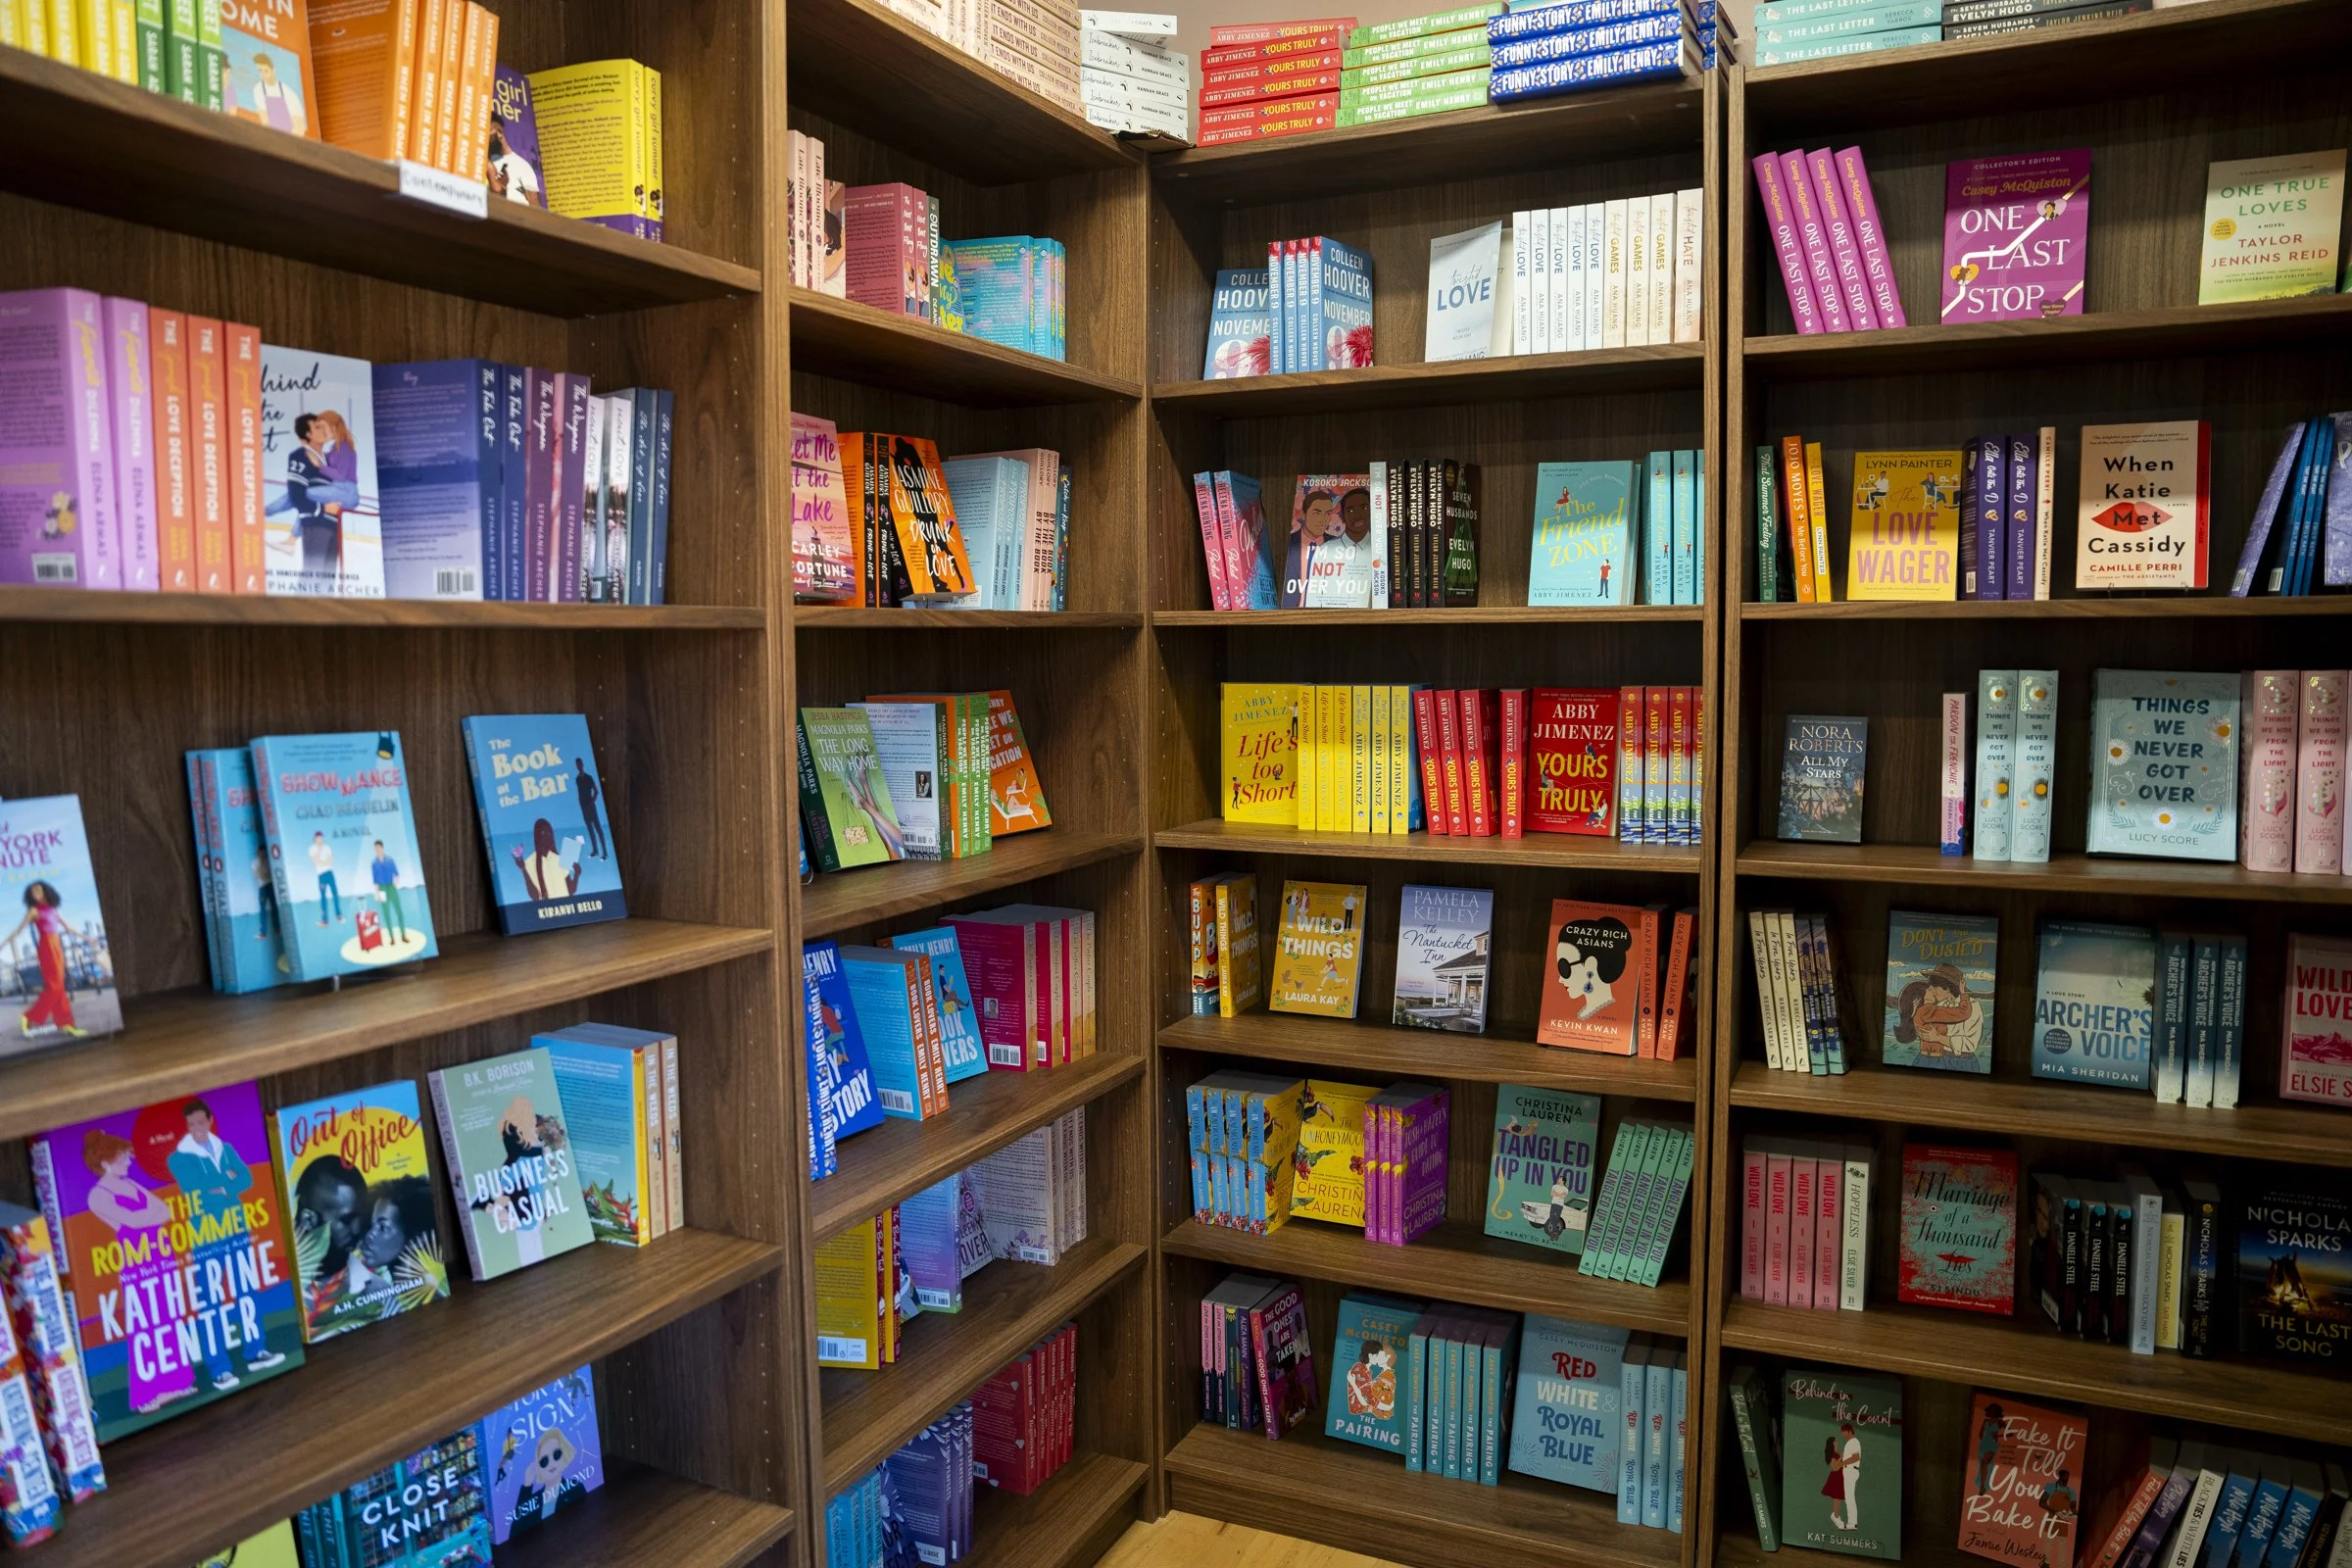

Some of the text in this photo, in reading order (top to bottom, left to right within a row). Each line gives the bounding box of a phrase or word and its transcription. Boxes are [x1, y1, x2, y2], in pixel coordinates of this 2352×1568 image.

[1953, 4, 2033, 22] EVELYN HUGO
[1788, 18, 1875, 38] THE LAST LETTER
[1206, 49, 1256, 64] ABBY JIMENEZ
[1266, 38, 1317, 55] YOURS TRULY
[1588, 49, 1657, 75] EMILY HENRY
[1083, 70, 1115, 87] Icebreaker
[1502, 62, 1574, 90] FUNNY STORY
[497, 78, 527, 106] girl
[2221, 177, 2329, 198] ONE TRUE
[2239, 199, 2307, 216] LOVES
[1961, 205, 2026, 233] ONE
[930, 213, 939, 288] OUTDRAWN
[1684, 236, 1693, 265] HATE
[2238, 234, 2302, 248] TAYLOR
[1331, 247, 1362, 270] COLLEEN
[1987, 239, 2070, 270] LAST
[2211, 249, 2328, 268] JENKINS REID
[1324, 264, 1370, 298] HOOVER
[1438, 277, 1490, 311] LOVE
[1968, 284, 2045, 314] STOP
[1324, 299, 1371, 325] NOVEMBER
[814, 433, 836, 462] Me
[1867, 459, 1952, 469] LYNN PAINTER
[2104, 456, 2174, 471] When
[808, 466, 829, 487] the
[893, 465, 941, 490] JASMINE
[2105, 483, 2171, 499] Katie
[895, 490, 950, 514] GUILLORY
[1446, 507, 1478, 519] HUSBANDS
[1539, 497, 1625, 546] Friend
[2113, 511, 2161, 525] Met
[909, 519, 956, 543] DRUNK
[1873, 513, 1938, 546] LOVE
[1305, 546, 1355, 560] I'M SO
[1449, 539, 1474, 551] EVELYN
[1549, 532, 1618, 567] ZONE
[2087, 536, 2185, 556] Cassidy
[926, 555, 956, 577] LOVE
[1312, 563, 1345, 576] NOT
[1452, 558, 1471, 569] HUGO
[1857, 550, 1949, 584] WAGER
[1287, 579, 1369, 593] OVER YOU
[1245, 697, 1274, 708] ABBY
[1552, 704, 1598, 718] ABBY
[2132, 697, 2210, 714] THINGS
[810, 712, 829, 721] JESSA
[1234, 708, 1288, 721] JIMENEZ
[810, 724, 868, 735] MAGNOLIA PARKS
[1534, 724, 1614, 740] JIMENEZ
[1801, 726, 1852, 739] NORA
[2154, 719, 2184, 735] WE
[489, 739, 512, 751] The
[817, 737, 869, 754] THE LONG
[1238, 730, 1298, 760] Life's
[1788, 738, 1863, 753] ROBERTS
[2134, 741, 2204, 759] NEVER
[492, 743, 563, 779] Book
[819, 755, 878, 772] WAY HOME
[1252, 762, 1284, 780] too
[1537, 753, 1608, 778] YOURS
[1800, 756, 1825, 765] ALL
[2146, 763, 2190, 779] GOT
[281, 768, 403, 796] SHOWMANCE
[1806, 767, 1840, 778] STARS
[520, 772, 569, 802] Bar
[1240, 781, 1297, 805] Short
[2138, 785, 2195, 803] OVER
[499, 795, 519, 808] the
[1539, 787, 1603, 812] TRULY
[0, 829, 63, 852] YORK
[2130, 833, 2199, 846] LUCY SCORE
[1415, 890, 1479, 907] PAMELA
[1298, 915, 1344, 933] WILD
[1413, 906, 1479, 923] KELLEY
[1403, 931, 1474, 950] Nantucket
[1566, 926, 1628, 940] CRAZY RICH
[1577, 938, 1614, 948] ASIANS
[928, 937, 954, 955] HENRY
[1283, 937, 1353, 958] THINGS
[1420, 949, 1446, 964] Inn
[923, 979, 937, 1034] BOOK LOVERS
[1286, 992, 1340, 1004] LAURA KAY
[1550, 1019, 1617, 1035] KEVIN KWAN
[2035, 1000, 2152, 1035] ARCHER'S
[931, 1039, 941, 1063] EMILY
[2081, 1031, 2149, 1061] VOICE
[487, 1058, 535, 1080] BORISON
[2042, 1063, 2138, 1082] MIA SHERIDAN
[2291, 1074, 2336, 1095] ELSIE
[1515, 1097, 1582, 1115] CHRISTINA
[1522, 1107, 1571, 1123] LAUREN
[289, 1101, 367, 1157] Out of
[340, 1115, 422, 1174] Office
[1498, 1128, 1590, 1168] TANGLED
[473, 1150, 569, 1201] BUSINESS
[1494, 1155, 1588, 1194] UP IN YOU
[166, 1190, 204, 1223] THE
[494, 1186, 569, 1235] CASUAL
[1849, 1184, 1860, 1238] HOPELESS
[91, 1198, 270, 1277] ROM-COMMERS
[2267, 1229, 2342, 1252] SPARKS
[98, 1241, 279, 1342] KATHERINE
[334, 1278, 425, 1315] A.H. CUNNINGHAM
[2258, 1313, 2351, 1341] THE LAST
[132, 1296, 260, 1382] CENTER
[2276, 1337, 2332, 1356] SONG
[1538, 1380, 1616, 1412] WHITE &
[1791, 1379, 1851, 1400] Behind in
[510, 1391, 576, 1446] SIGN
[1360, 1415, 1375, 1424] THE
[1537, 1406, 1604, 1438] ROYAL
[1833, 1401, 1891, 1427] the Count
[1336, 1420, 1400, 1446] PAIRING
[2003, 1415, 2086, 1450] Fake It
[1540, 1436, 1594, 1465] BLUE
[2018, 1446, 2066, 1479] Till
[1989, 1464, 2045, 1501] You
[364, 1466, 459, 1525] CLOSE
[504, 1465, 596, 1526] SUSIE DUMOND
[381, 1498, 450, 1549] KNIT
[1967, 1495, 2073, 1539] Bake It
[1807, 1532, 1878, 1549] KAT SUMMERS
